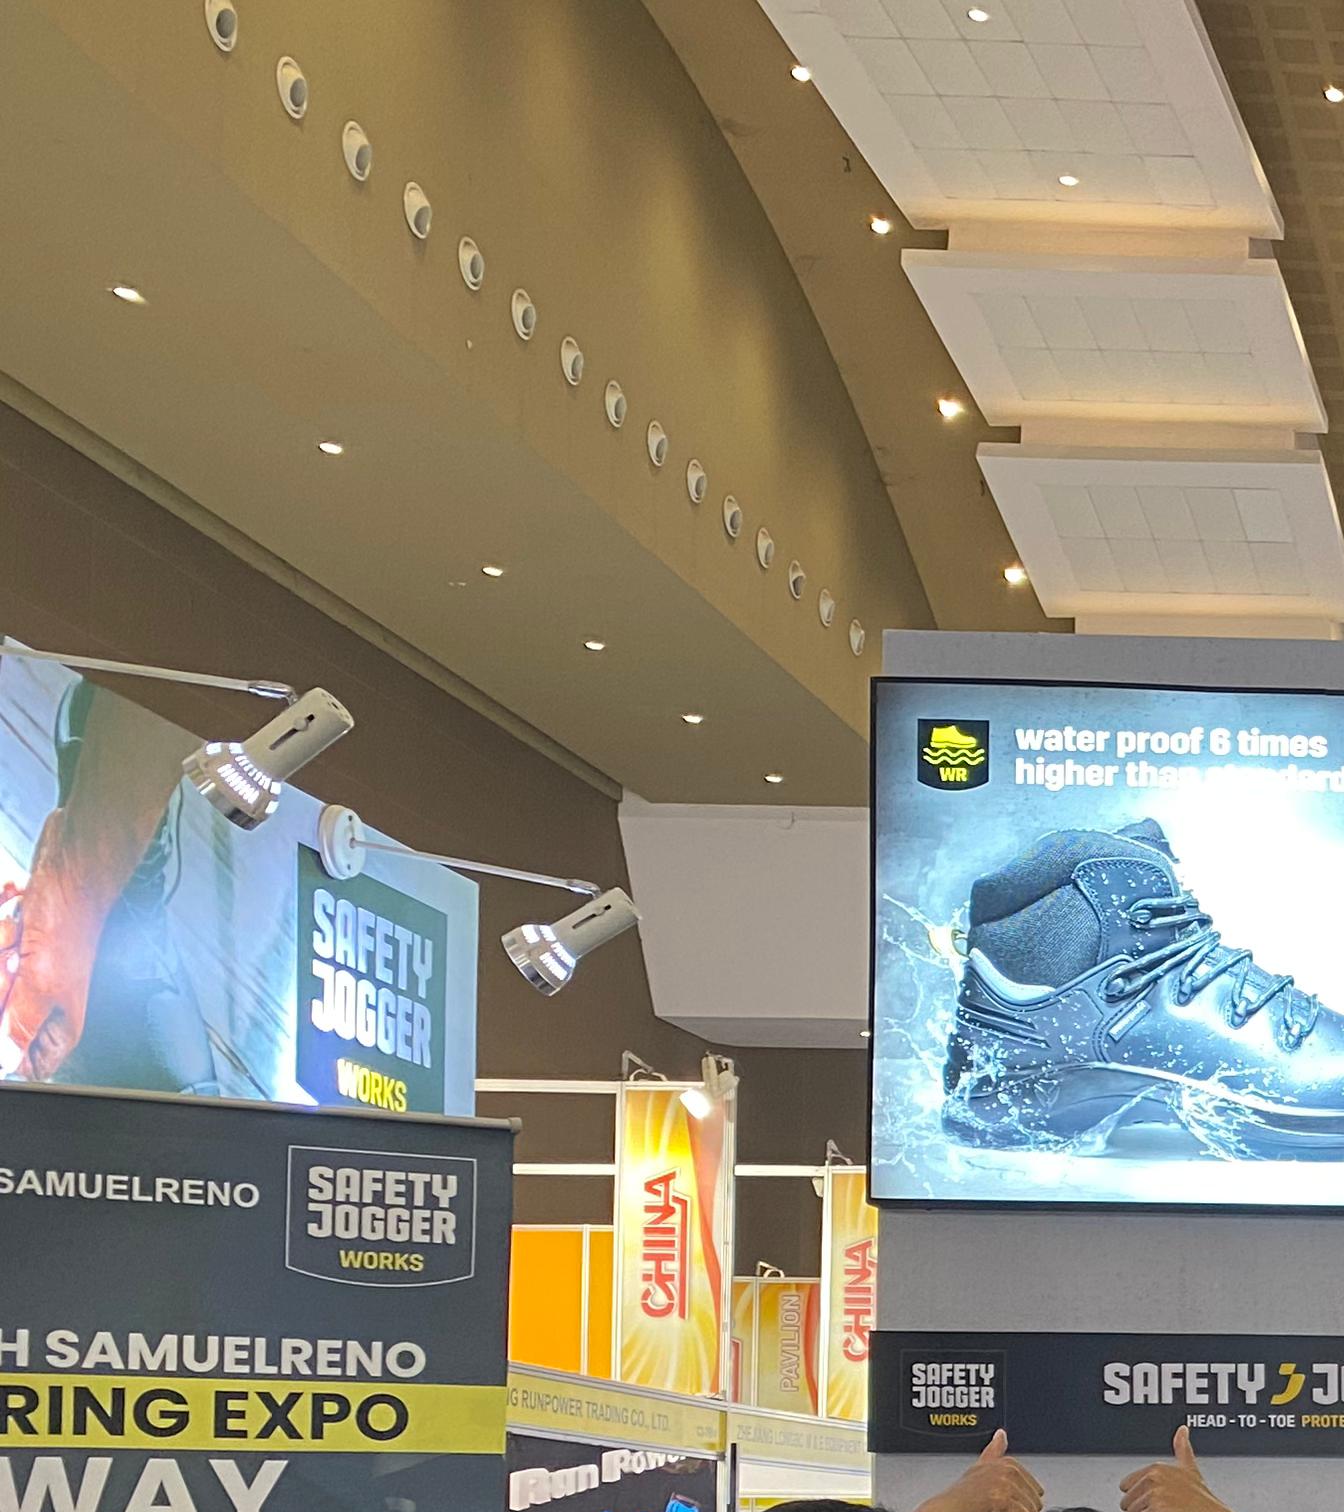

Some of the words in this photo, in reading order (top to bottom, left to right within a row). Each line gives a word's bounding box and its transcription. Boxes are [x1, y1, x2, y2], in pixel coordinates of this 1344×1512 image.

[1015, 726, 1110, 752] water
[1117, 727, 1204, 758] proof
[1209, 728, 1231, 756] 6
[1238, 728, 1328, 758] times
[939, 768, 967, 781] WR
[1015, 757, 1119, 791] higher
[313, 888, 432, 999] SAFETY
[312, 958, 431, 1069] JOGGER
[337, 1057, 407, 1113] WORKS
[0, 1167, 260, 1208] SAMUELRENO
[307, 1165, 458, 1208] SAFETY
[306, 1203, 456, 1245] JOGGER
[641, 1168, 684, 1319] CHINA
[339, 1249, 424, 1272] WORKS
[843, 1238, 877, 1362] CHINA
[45, 1329, 427, 1379] SAMUELRENO
[780, 1294, 801, 1392] PAVILION
[911, 1363, 995, 1386] SAFETY
[1103, 1362, 1266, 1405] SAFETY
[213, 1391, 409, 1442] EXPO
[521, 1391, 583, 1418] RUNPOWER
[585, 1401, 629, 1424] TRADING
[911, 1385, 995, 1408] JOGGER
[929, 1414, 977, 1426] WORKS
